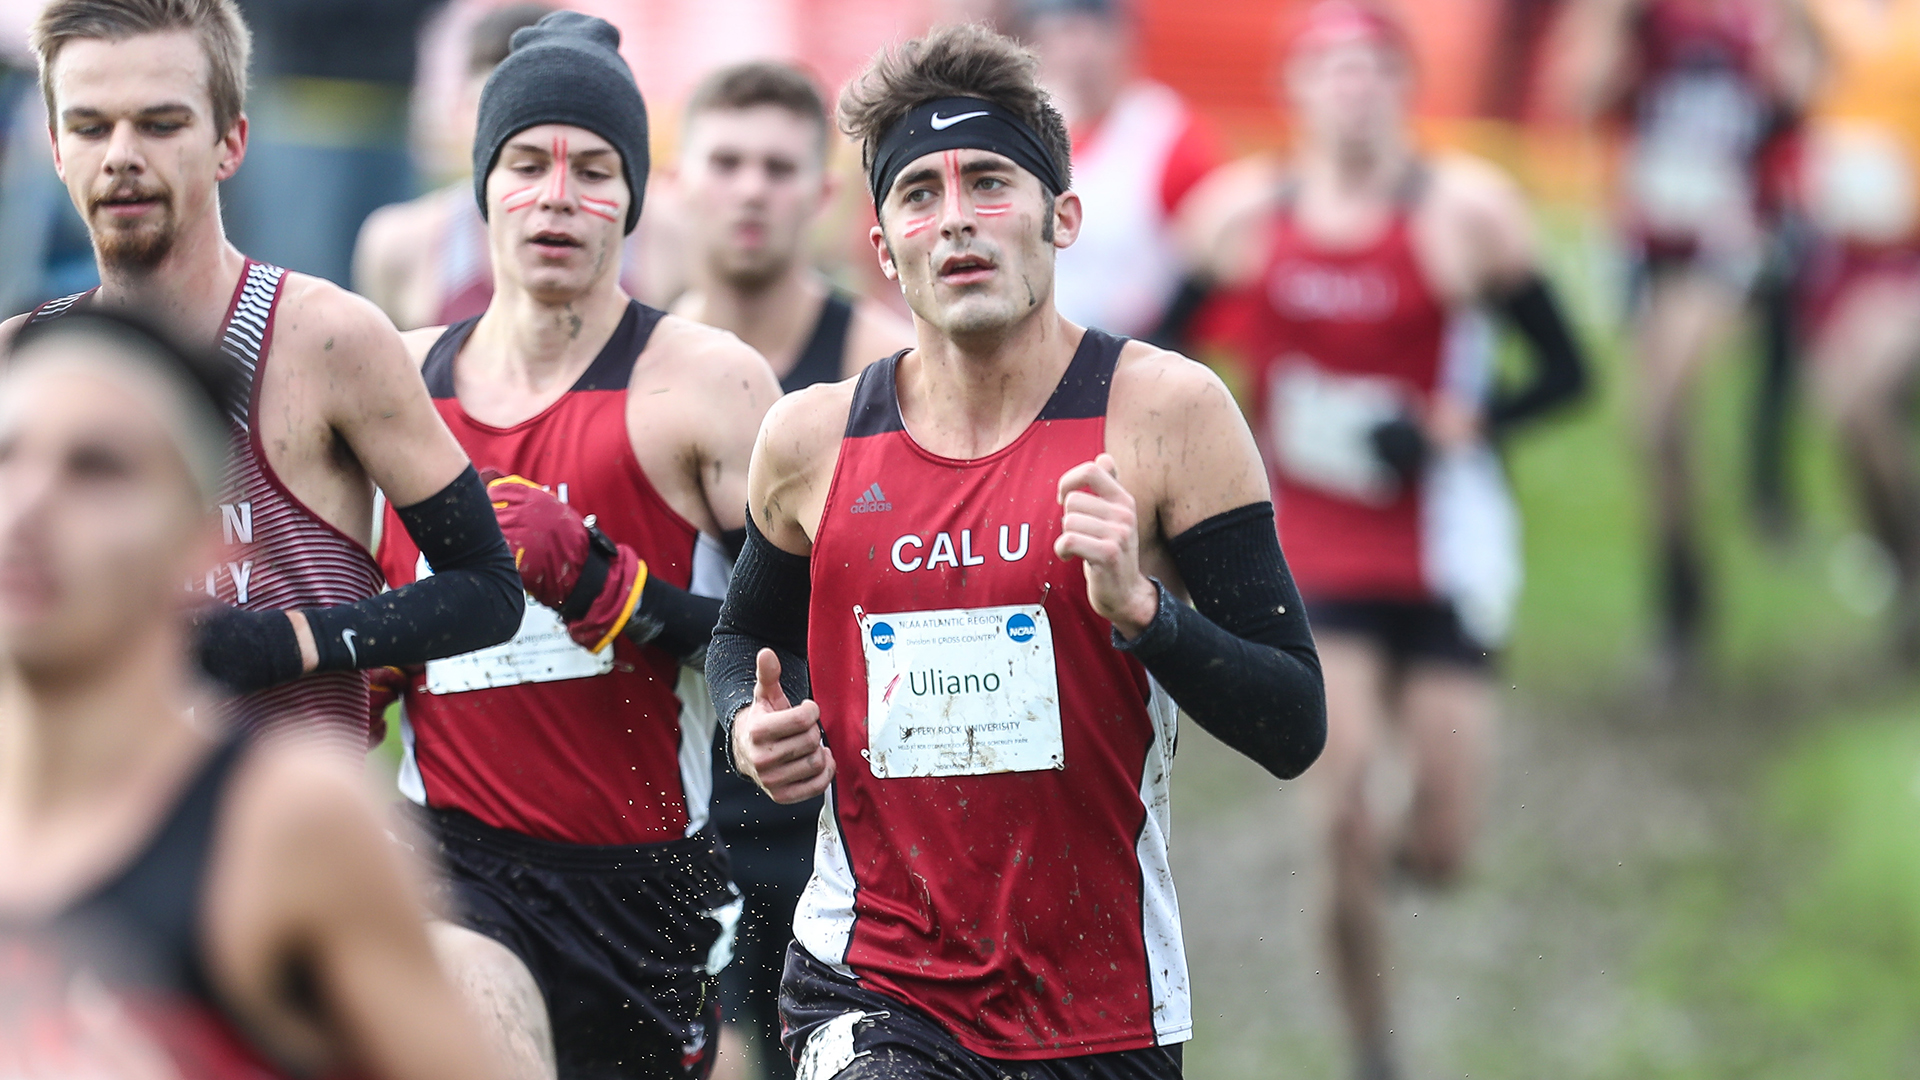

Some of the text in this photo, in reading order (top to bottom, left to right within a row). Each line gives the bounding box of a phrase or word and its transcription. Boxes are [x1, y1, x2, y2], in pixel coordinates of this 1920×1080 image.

[850, 501, 892, 514] adidas
[890, 522, 1031, 573] CAL U
[898, 614, 1003, 629] NCAA ATLANTIC REGION
[1009, 625, 1037, 637] NCAA
[937, 635, 961, 645] CROSS
[961, 632, 998, 643] COUNTRY
[909, 668, 1001, 697] Uliano
[900, 725, 936, 736] SPPERY
[938, 725, 962, 735] ROCK
